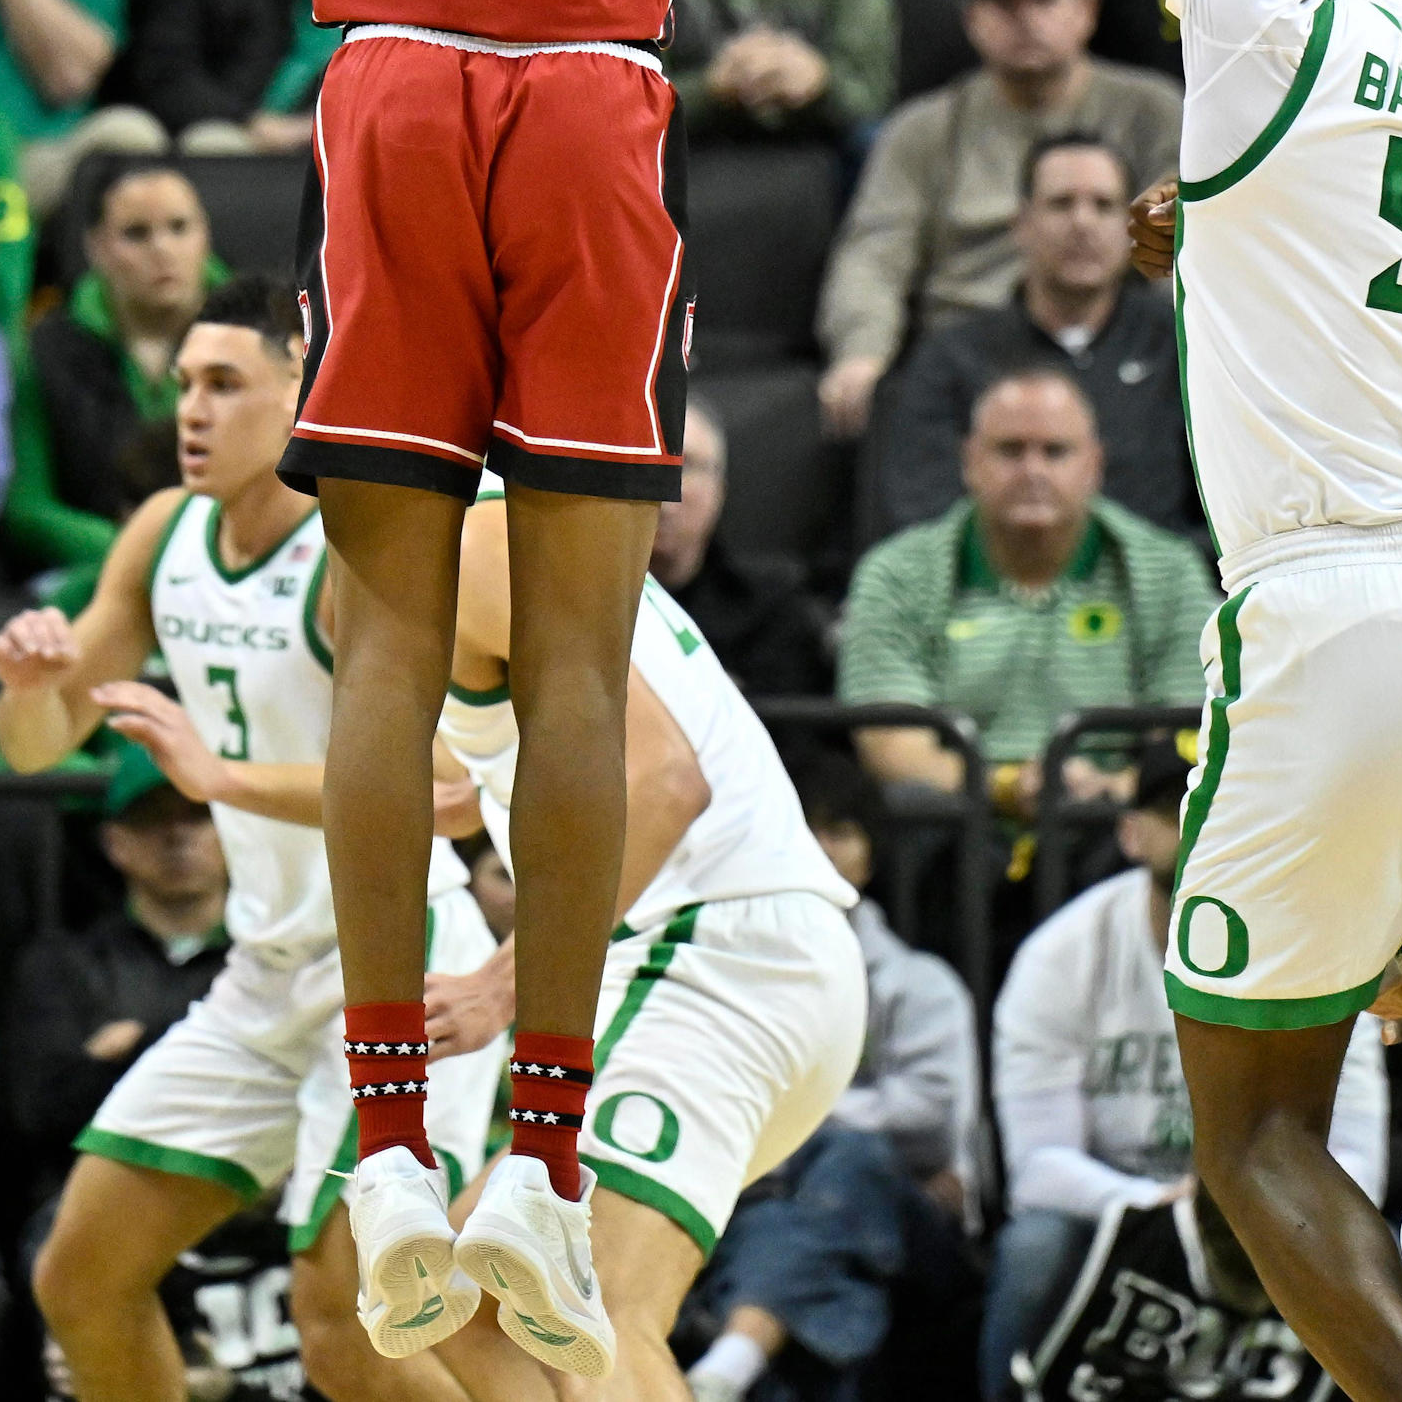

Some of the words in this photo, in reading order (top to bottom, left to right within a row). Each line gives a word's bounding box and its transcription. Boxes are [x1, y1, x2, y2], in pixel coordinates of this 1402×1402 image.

[163, 615, 289, 650] DUCKS
[207, 666, 251, 760] 3
[1177, 895, 1250, 978] O
